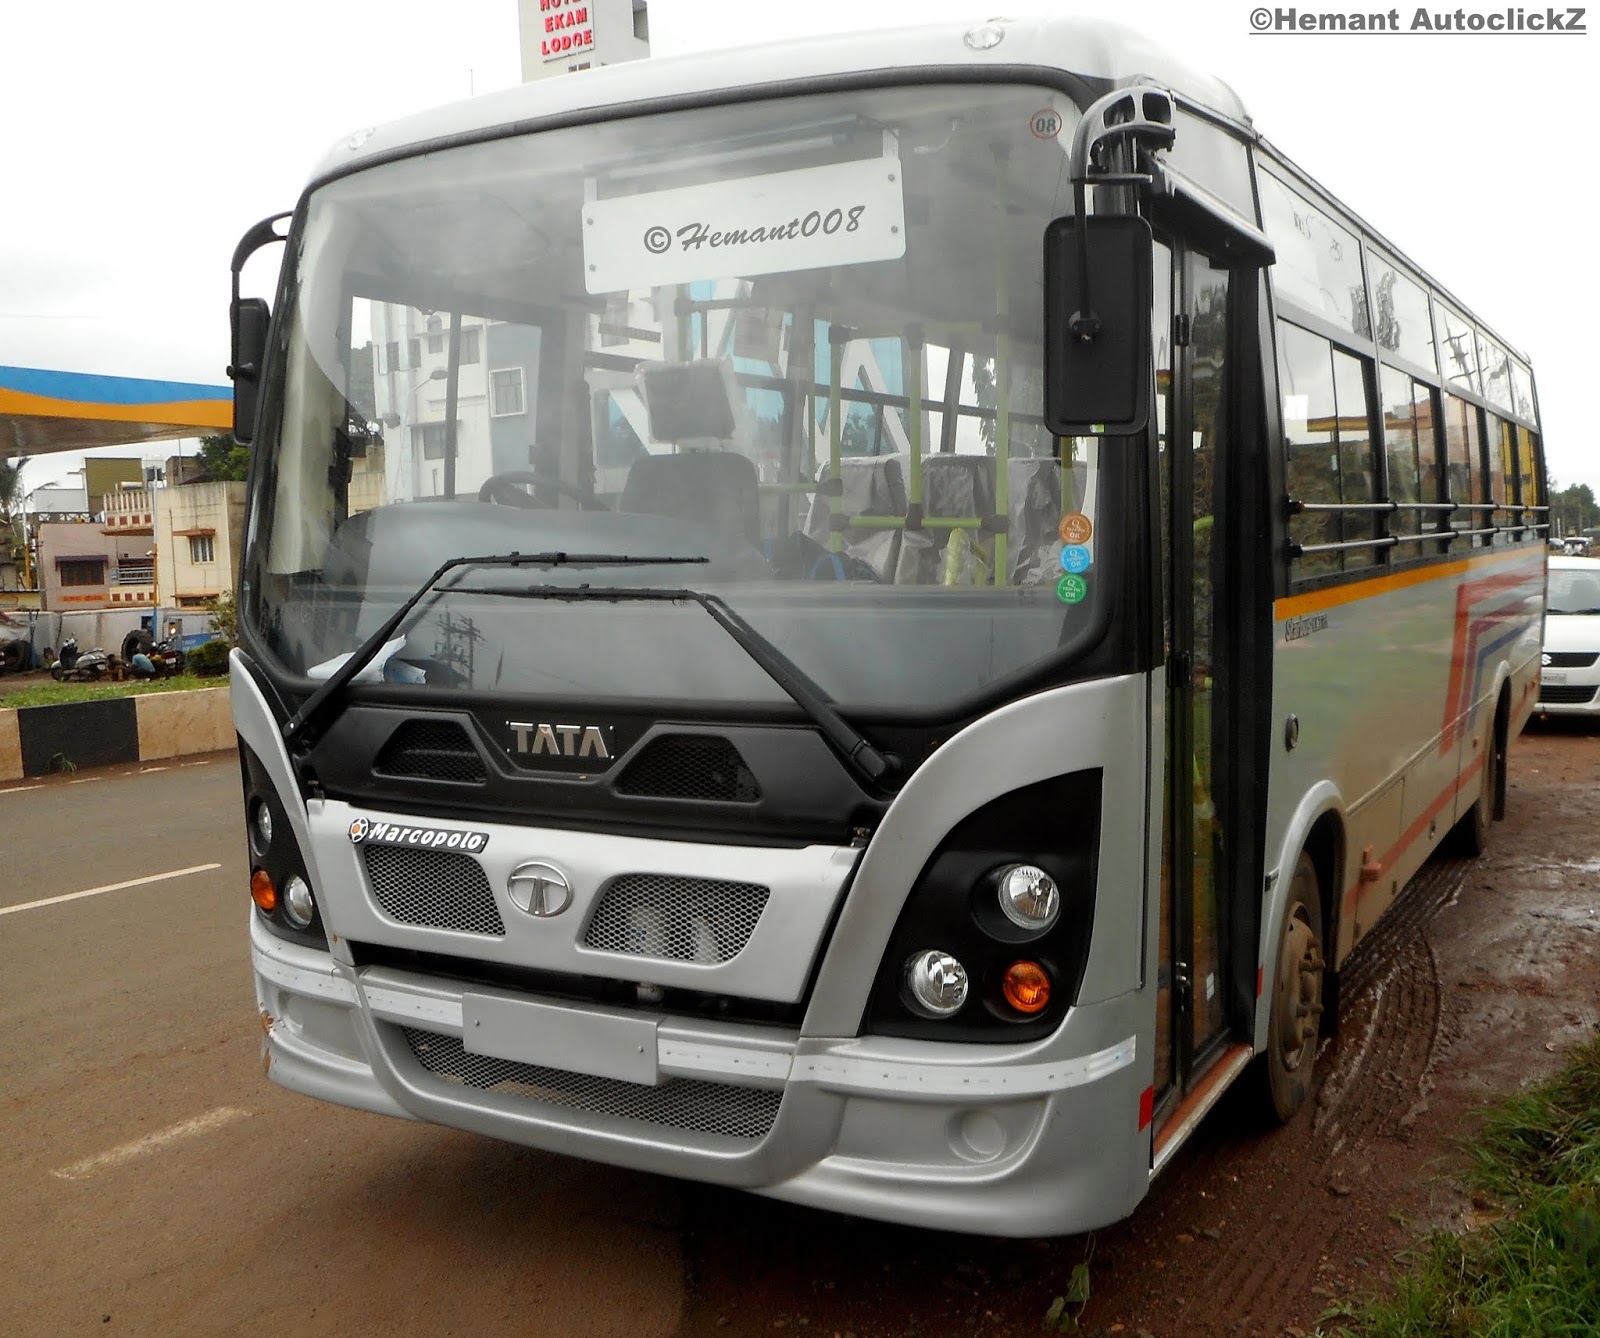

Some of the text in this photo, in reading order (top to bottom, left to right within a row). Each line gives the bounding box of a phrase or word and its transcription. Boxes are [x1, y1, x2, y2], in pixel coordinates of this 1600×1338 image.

[544, 7, 588, 33] EKAM
[541, 29, 593, 56] LODGE
[1036, 118, 1056, 133] 08
[1065, 591, 1077, 599] OK
[510, 722, 609, 758] TATA
[370, 823, 482, 850] Marcopolo
